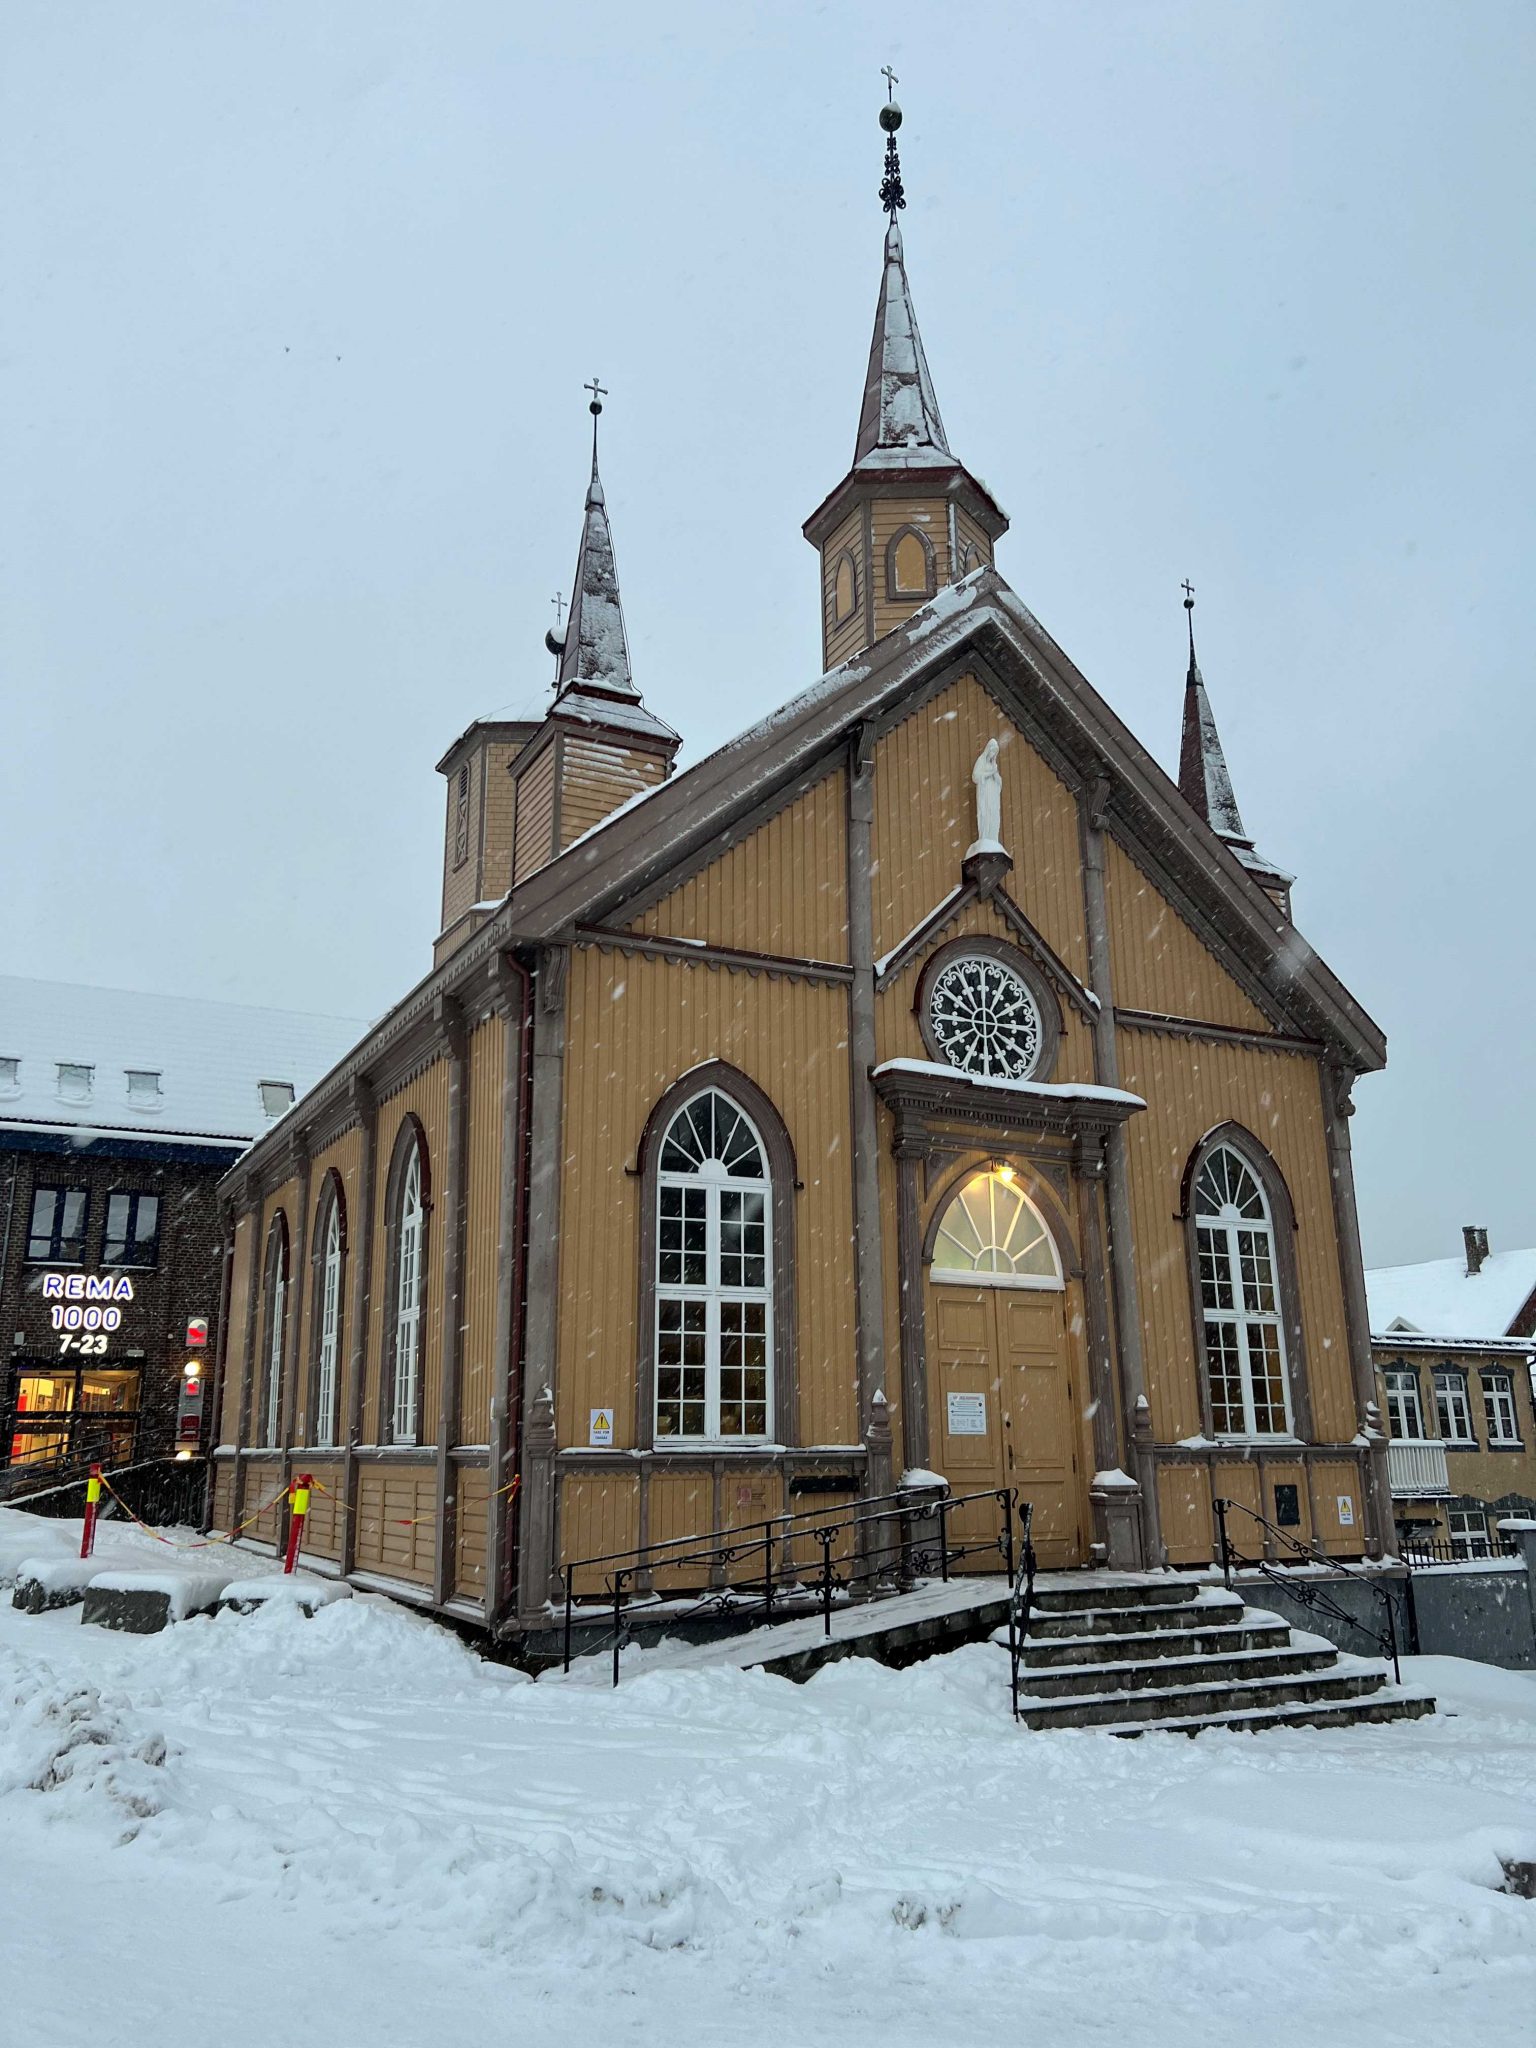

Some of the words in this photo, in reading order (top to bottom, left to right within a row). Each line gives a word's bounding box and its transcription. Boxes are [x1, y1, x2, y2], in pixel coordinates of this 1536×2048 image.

[43, 1274, 133, 1300] REMA
[51, 1305, 121, 1331] 1000
[60, 1334, 108, 1354] 7-23
